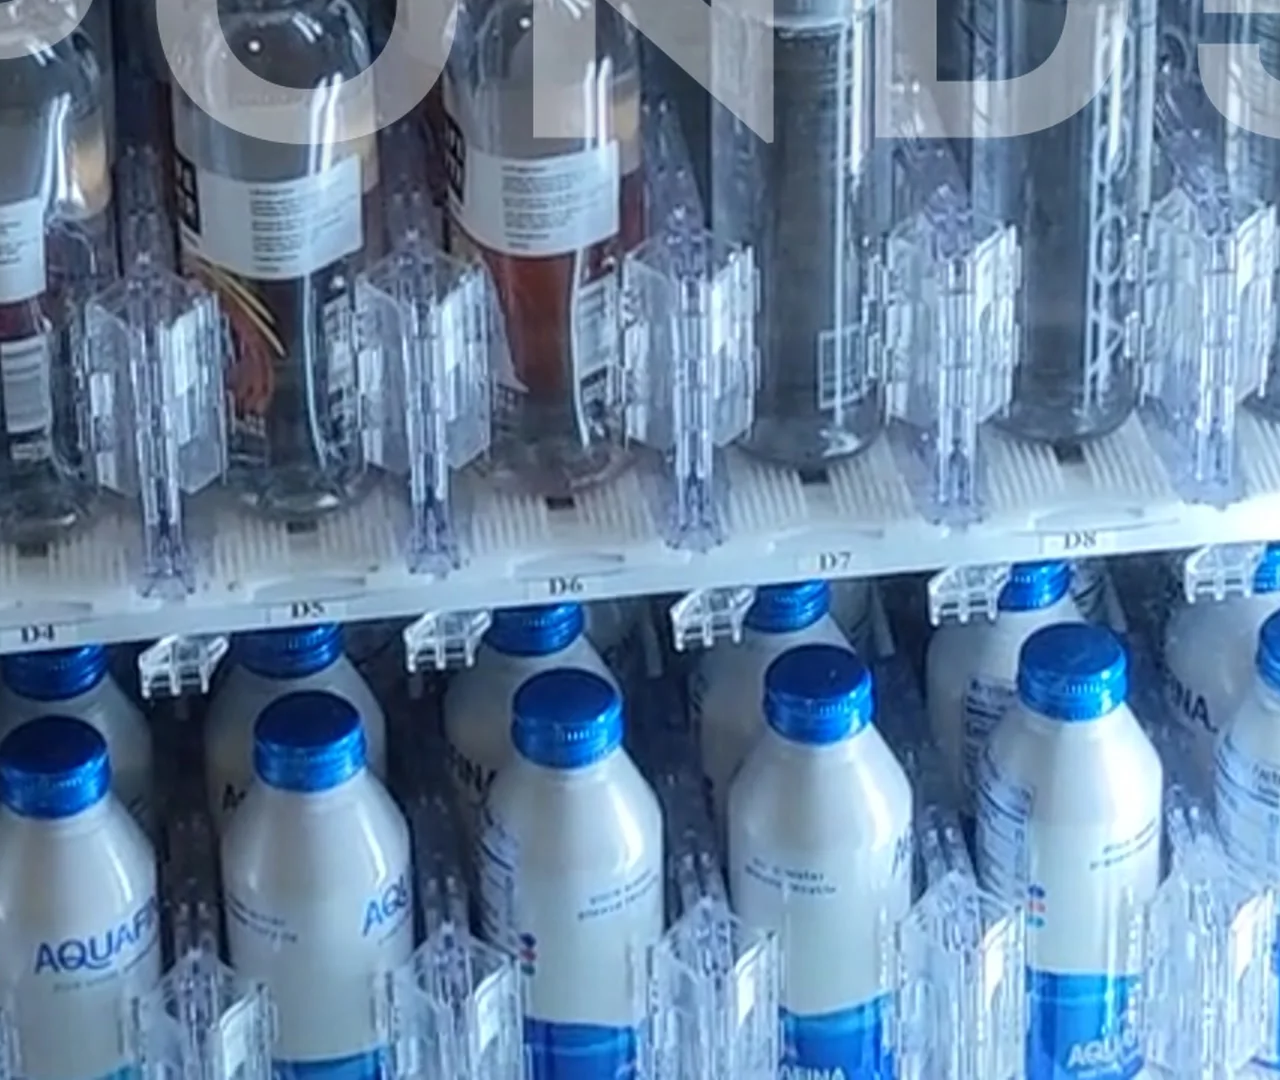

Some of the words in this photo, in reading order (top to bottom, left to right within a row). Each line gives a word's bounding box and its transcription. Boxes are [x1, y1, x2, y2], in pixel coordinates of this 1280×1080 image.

[1063, 530, 1097, 550] D8
[819, 551, 852, 572] D7
[548, 577, 584, 596] D6
[290, 601, 325, 620] D5
[21, 625, 56, 645] D4
